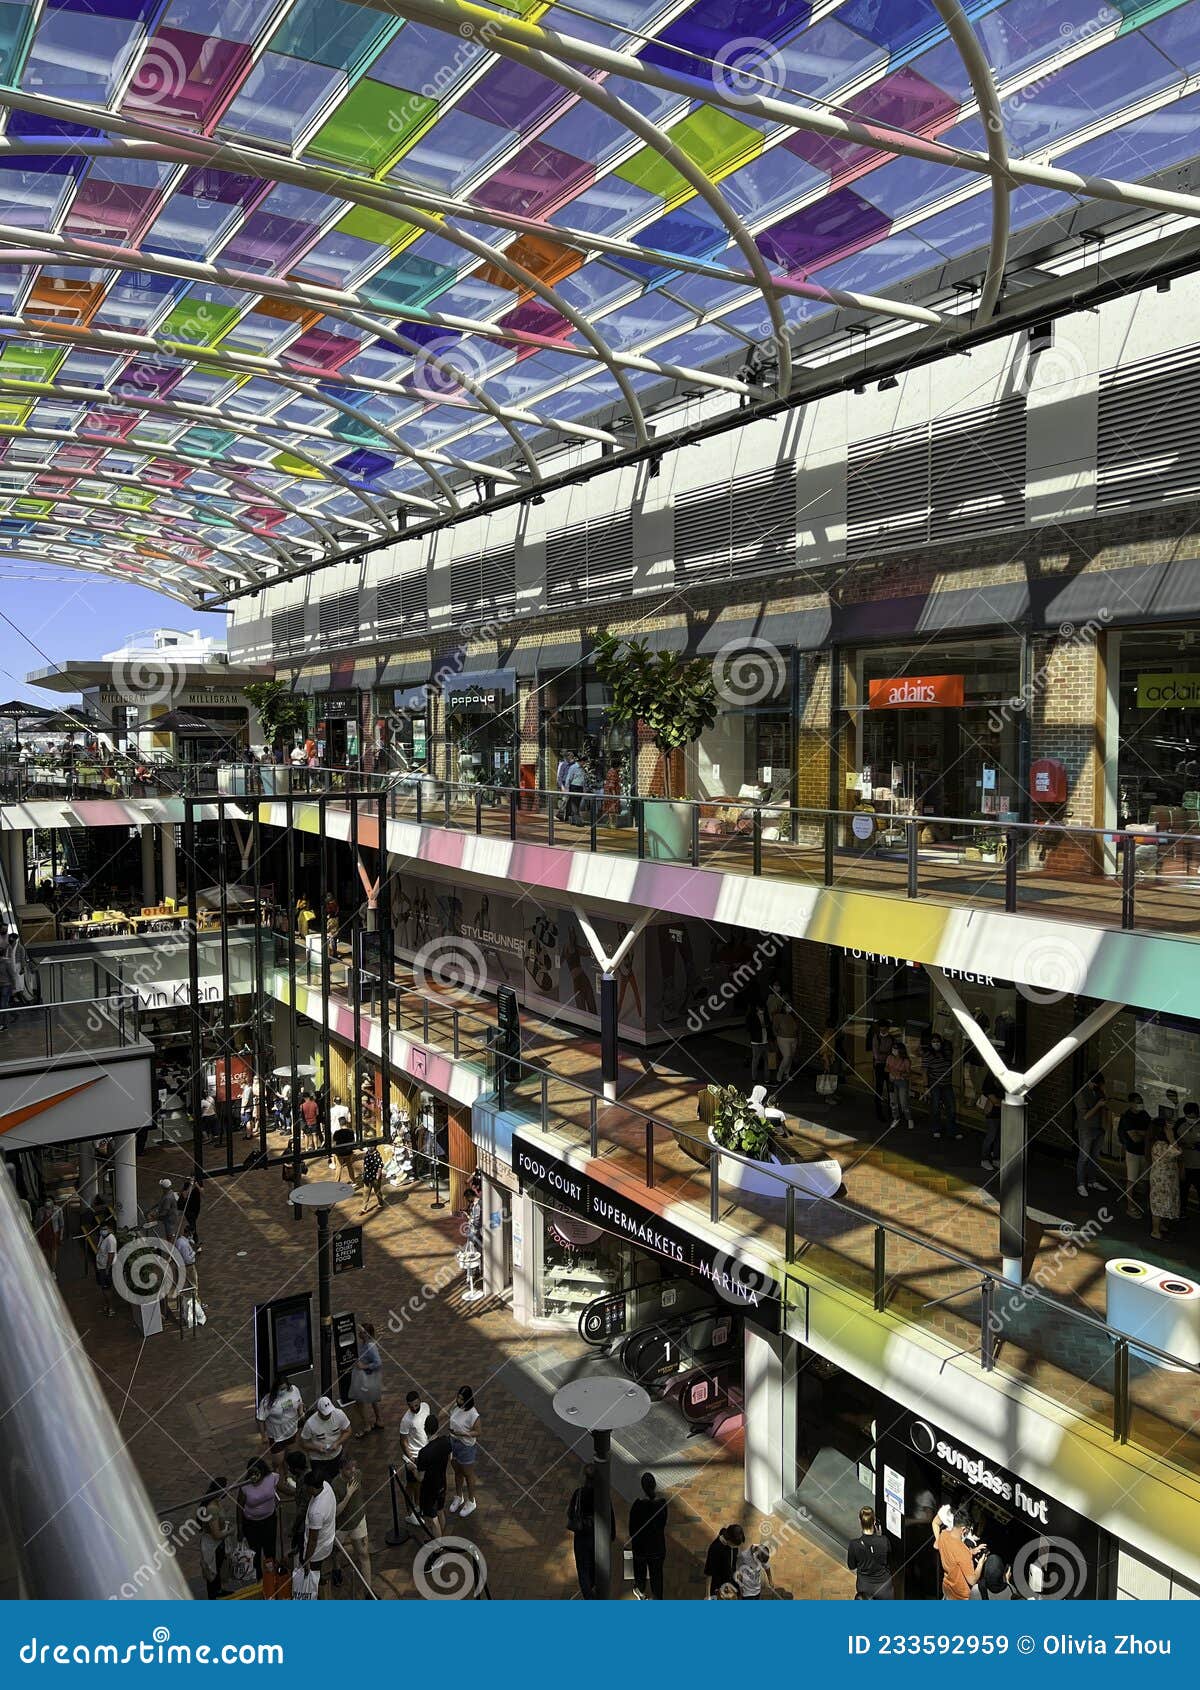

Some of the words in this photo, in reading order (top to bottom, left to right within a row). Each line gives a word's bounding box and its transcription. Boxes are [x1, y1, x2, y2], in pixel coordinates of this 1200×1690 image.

[189, 695, 238, 704] MILLIGRAM
[451, 695, 496, 708] papaya
[888, 680, 936, 703] adairs
[460, 924, 527, 953] STYLERUNNER
[843, 946, 900, 966] TOMMY
[942, 966, 995, 987] LFIGER
[518, 1152, 547, 1179] FOOD
[548, 1171, 582, 1201] COURT
[593, 1196, 684, 1262] SUPERMARKETS
[700, 1258, 759, 1308] MARINA
[663, 1341, 671, 1362] 1
[712, 1376, 719, 1397] 1
[936, 1441, 1013, 1500] sunglass
[1014, 1483, 1049, 1525] hut
